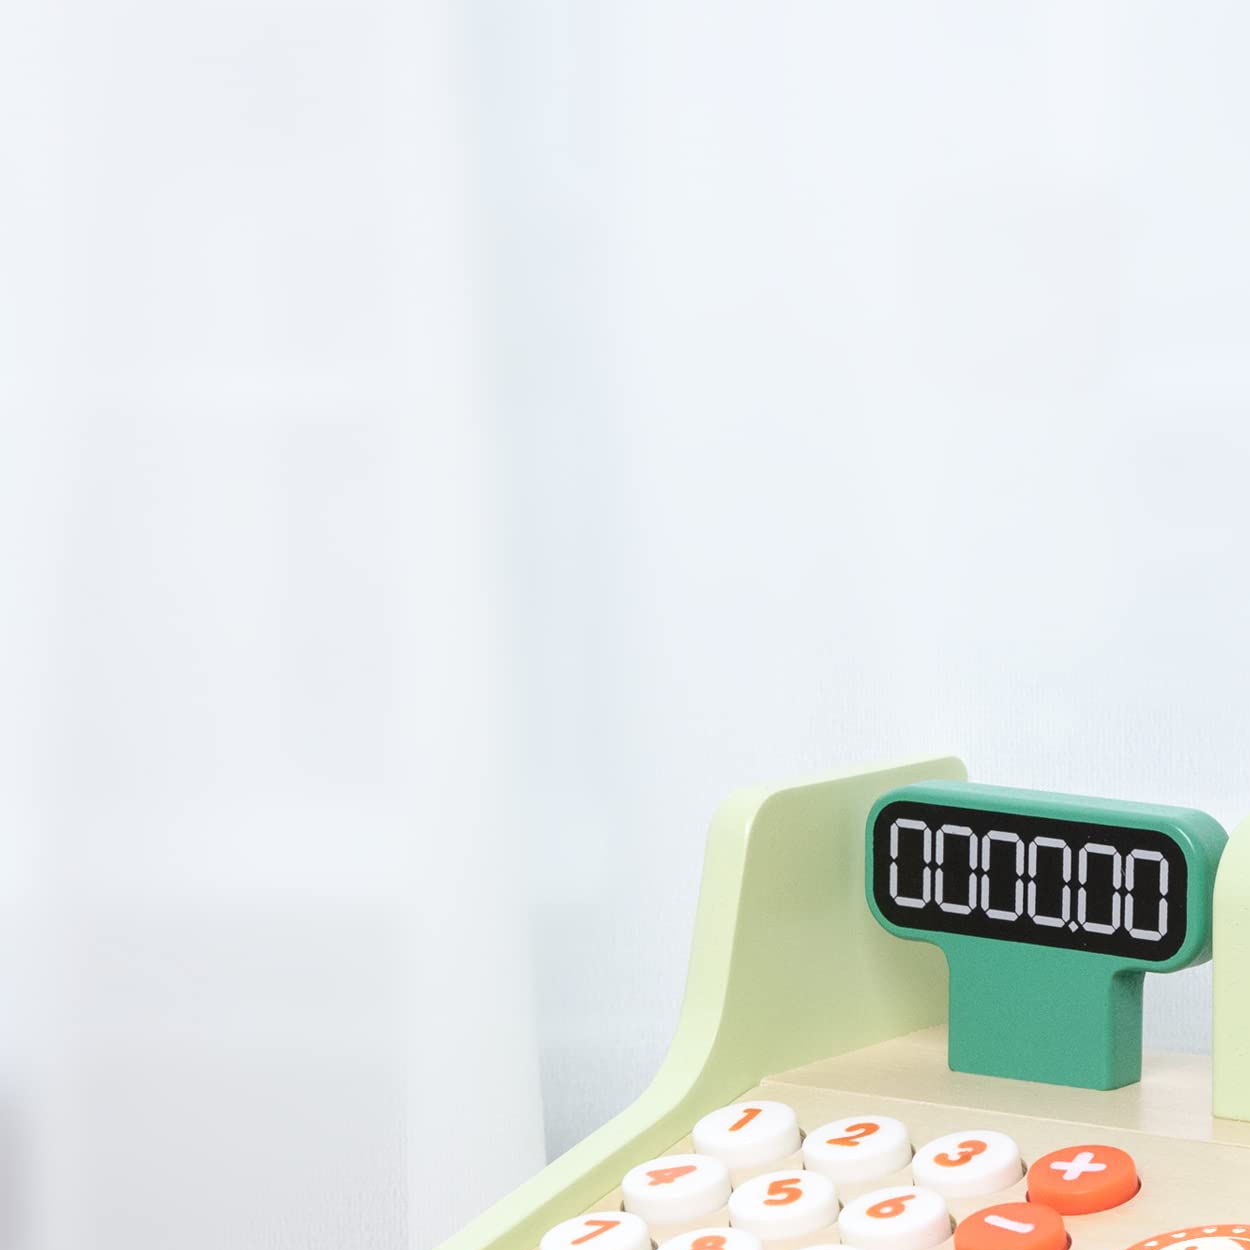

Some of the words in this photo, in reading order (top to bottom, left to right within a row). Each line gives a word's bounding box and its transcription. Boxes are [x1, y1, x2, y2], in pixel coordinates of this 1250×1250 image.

[889, 818, 1169, 942] 0000.00
[729, 1107, 763, 1132] 1
[826, 1122, 881, 1147] 2
[933, 1139, 988, 1168] 3
[646, 1164, 697, 1187] 4
[763, 1177, 803, 1206] 5
[865, 1194, 916, 1219] 6
[570, 1219, 621, 1246] 7
